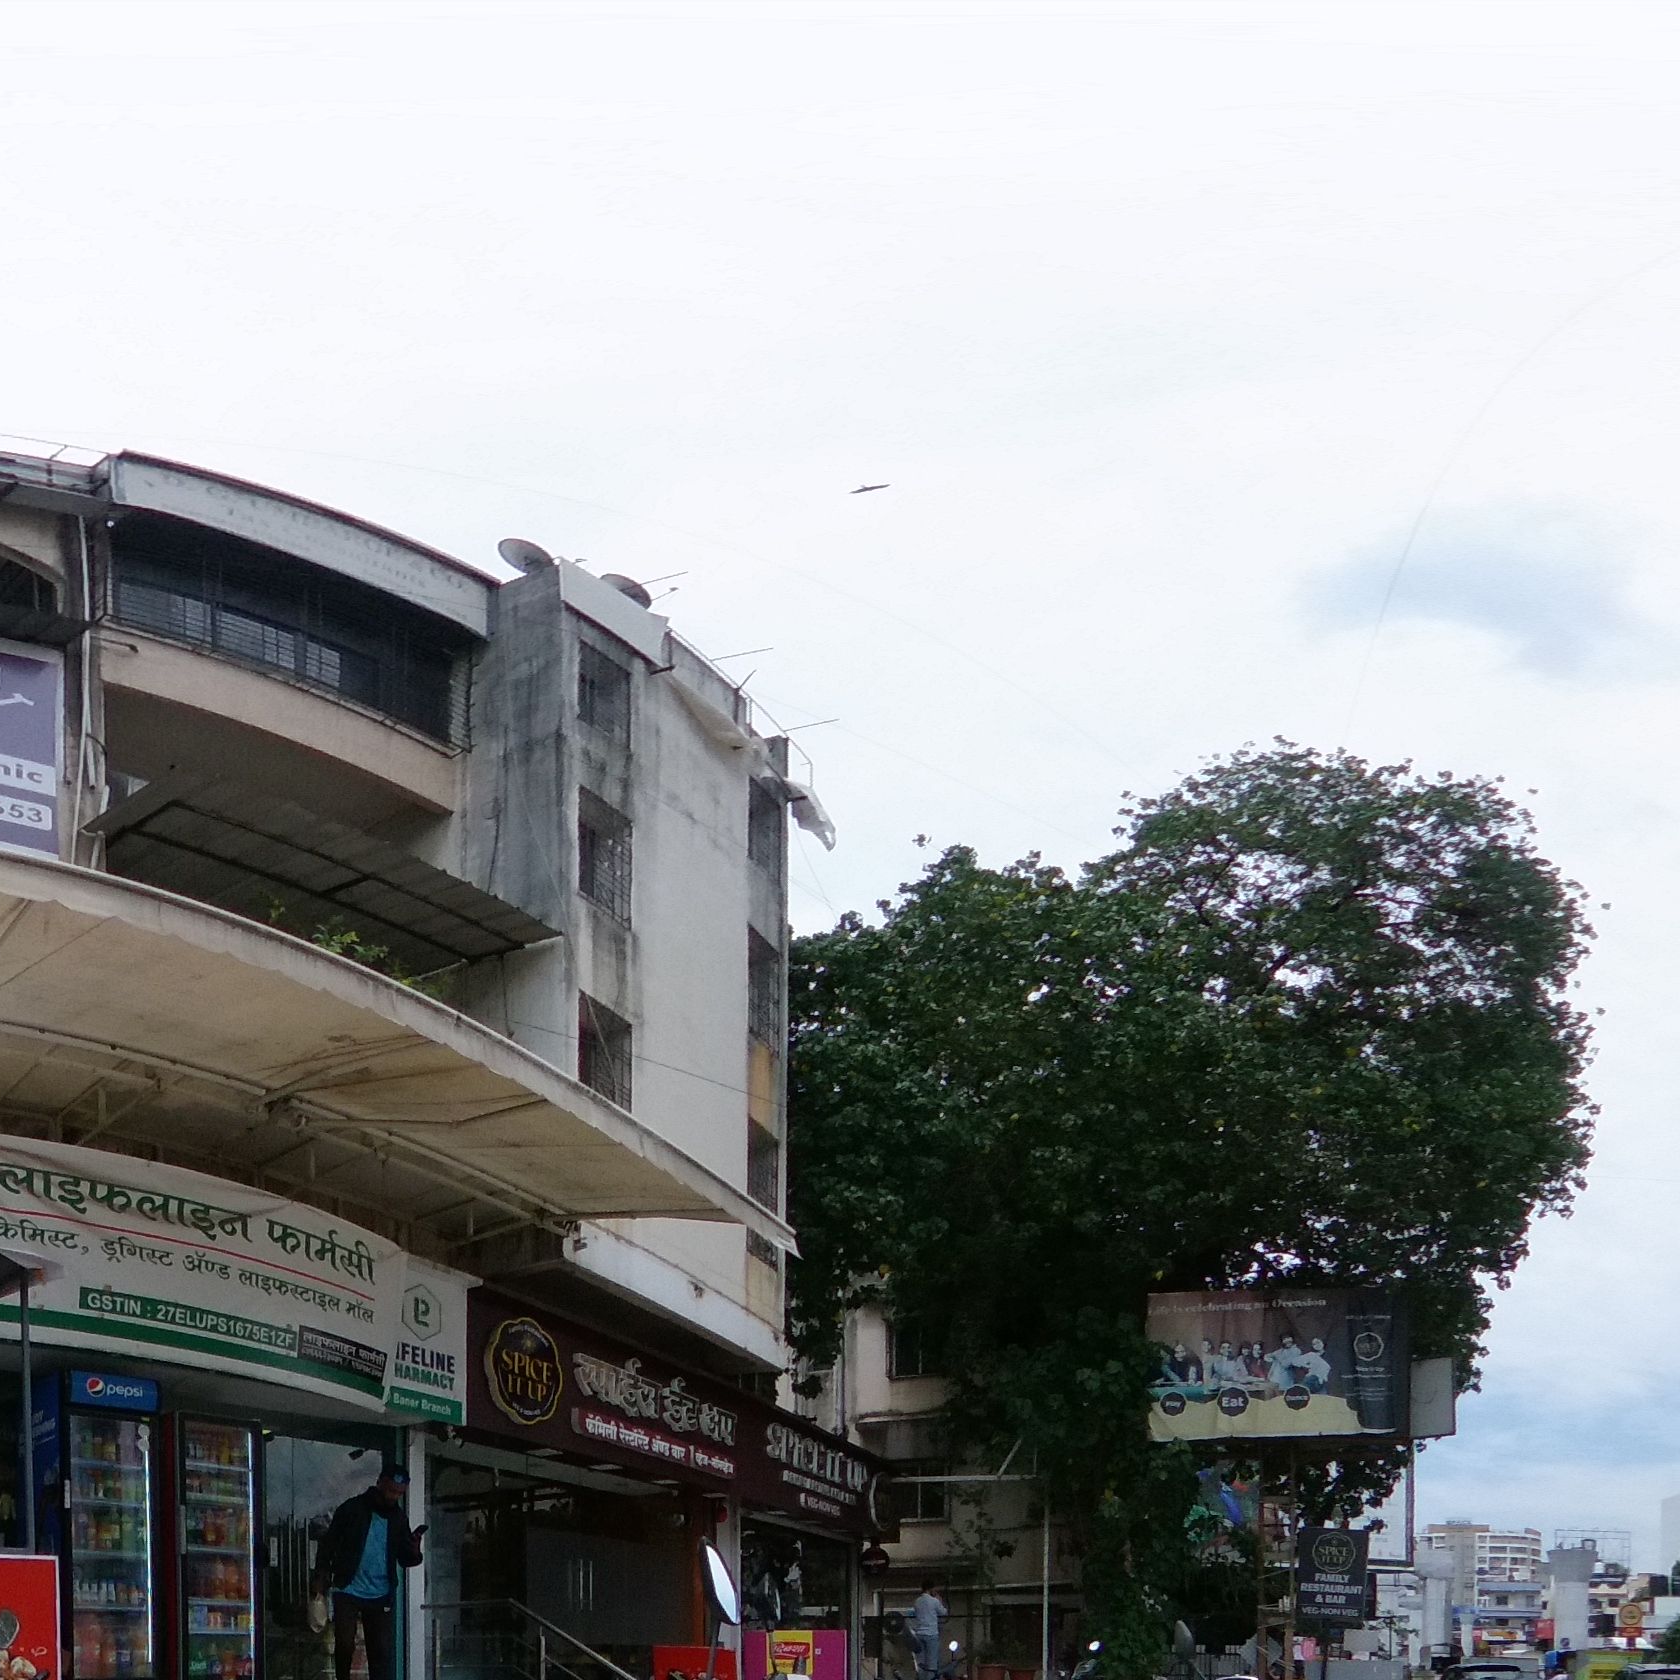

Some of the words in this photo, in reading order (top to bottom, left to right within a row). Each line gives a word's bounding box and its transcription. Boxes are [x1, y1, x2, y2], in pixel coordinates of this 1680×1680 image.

[266, 1219, 376, 1285] फार्मसी
[88, 1292, 141, 1316] GSTIN
[395, 1340, 456, 1374] IFELINE
[502, 1348, 553, 1386] SPICE
[394, 1362, 455, 1391] HARMACY
[107, 1384, 143, 1398] pepsi
[508, 1373, 521, 1396] IT
[528, 1380, 547, 1402] UP
[421, 1399, 453, 1416] Branch
[1221, 1396, 1244, 1408] Eat
[1314, 1572, 1351, 1583] FAMILY
[1300, 1582, 1363, 1595] RESTAURANT
[1315, 1594, 1323, 1603] &
[1325, 1594, 1346, 1604] BAR
[1301, 1606, 1340, 1615] VEG-NON
[1342, 1608, 1360, 1617] VEG
